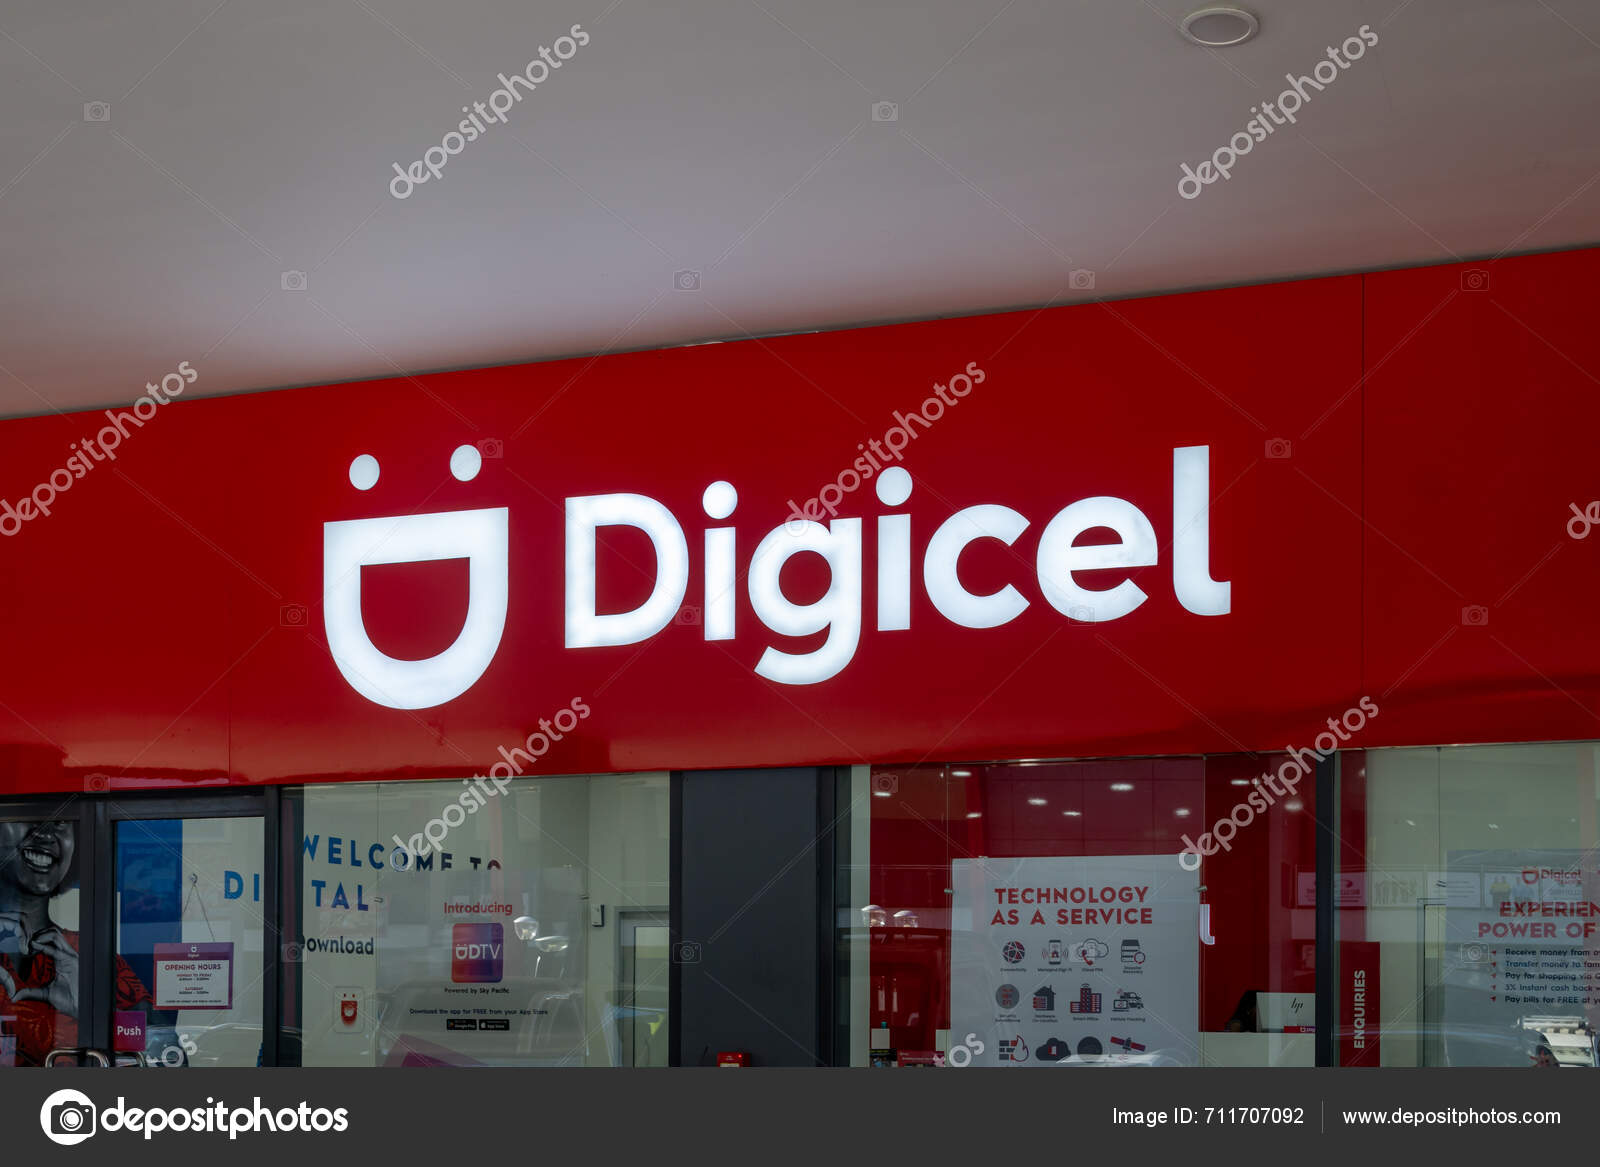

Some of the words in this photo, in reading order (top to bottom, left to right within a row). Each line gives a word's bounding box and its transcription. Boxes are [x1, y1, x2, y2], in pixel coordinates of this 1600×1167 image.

[565, 444, 1232, 686] Digicel
[993, 885, 1150, 905] TECHNOLOGY
[443, 901, 513, 916] Introducing
[990, 908, 1020, 926] AS
[1029, 908, 1047, 926] A
[1056, 907, 1153, 925] SERVICE
[1477, 921, 1557, 939] POWER
[1565, 921, 1597, 938] OF
[299, 935, 375, 956] ownload
[1504, 947, 1537, 957] Receive
[1540, 949, 1568, 958] money
[1571, 947, 1590, 956] from
[1505, 960, 1539, 968] Transfer
[1541, 961, 1569, 970] money
[1572, 960, 1582, 968] to
[1504, 971, 1521, 980] Pay
[1523, 971, 1536, 980] for
[1538, 972, 1577, 981] shopping
[470, 987, 478, 995] by
[479, 987, 490, 995] Sky
[1550, 983, 1571, 992] cash
[1572, 983, 1593, 992] back
[1504, 995, 1521, 1004] Pay
[1523, 995, 1540, 1004] bills
[1542, 995, 1556, 1004] for
[1557, 996, 1579, 1004] FREE
[1353, 969, 1366, 1050] ENQUIRIES
[116, 1025, 142, 1037] Push
